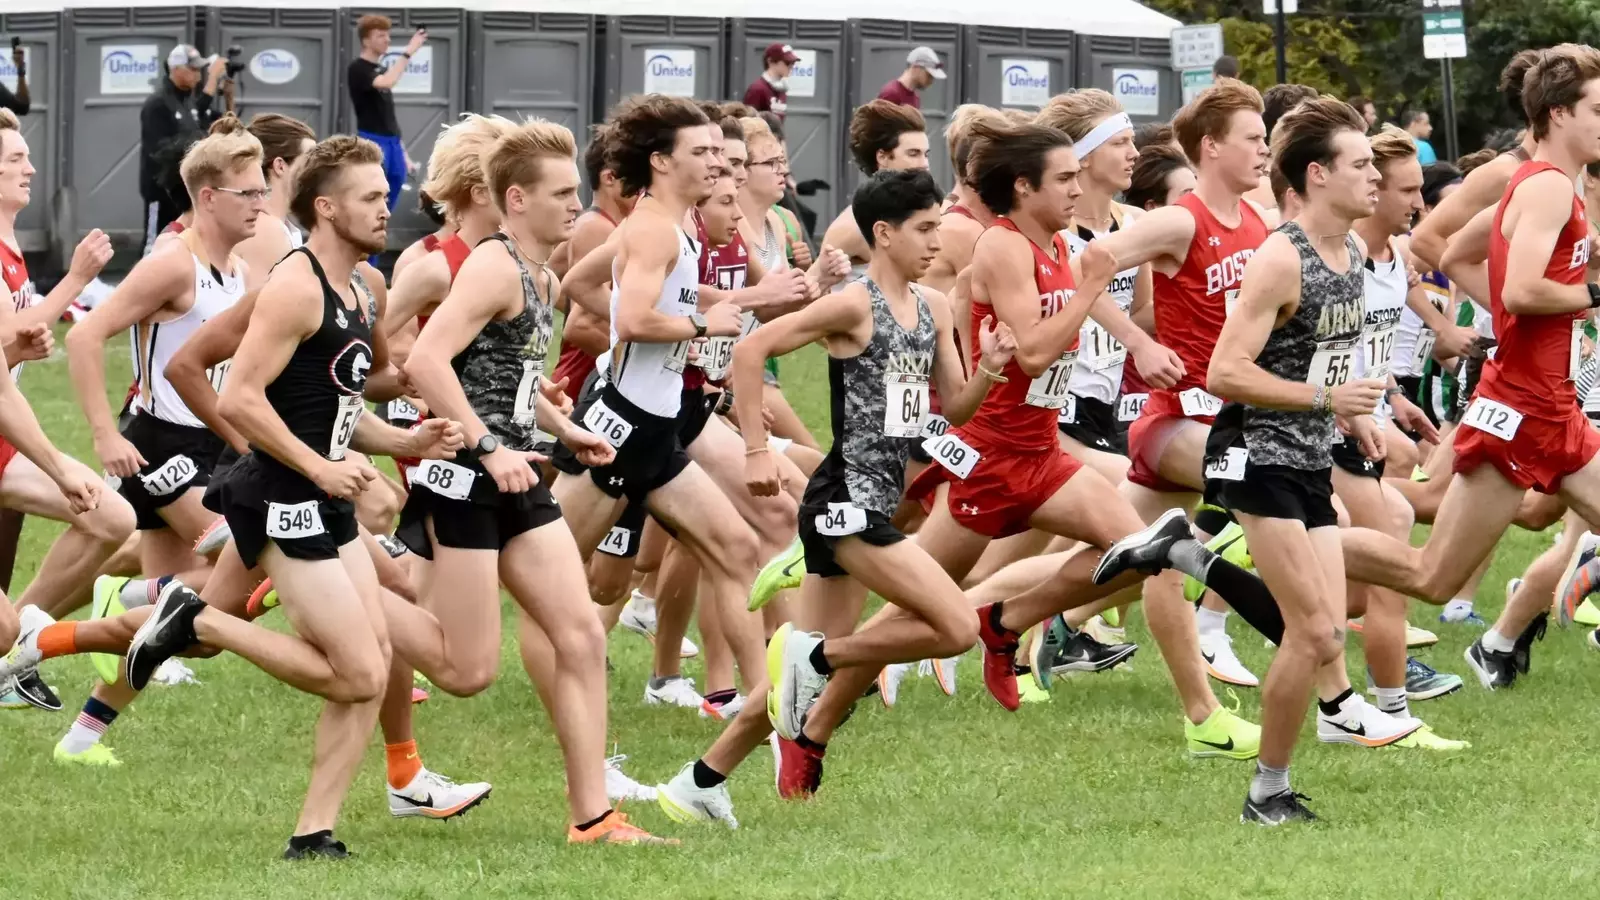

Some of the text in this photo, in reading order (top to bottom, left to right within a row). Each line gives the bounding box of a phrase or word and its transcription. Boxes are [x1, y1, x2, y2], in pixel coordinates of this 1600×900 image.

[109, 57, 157, 74] United
[652, 61, 692, 77] United
[1009, 72, 1048, 88] United
[1120, 81, 1157, 96] United
[1368, 332, 1393, 367] 112
[1325, 354, 1350, 387] 55
[902, 388, 920, 424] 64
[1475, 403, 1509, 431] 112
[588, 406, 626, 441] 1116
[926, 419, 951, 437] 40
[148, 459, 190, 493] 1120
[427, 464, 454, 489] 68
[278, 508, 313, 532] 549
[825, 509, 847, 530] 64
